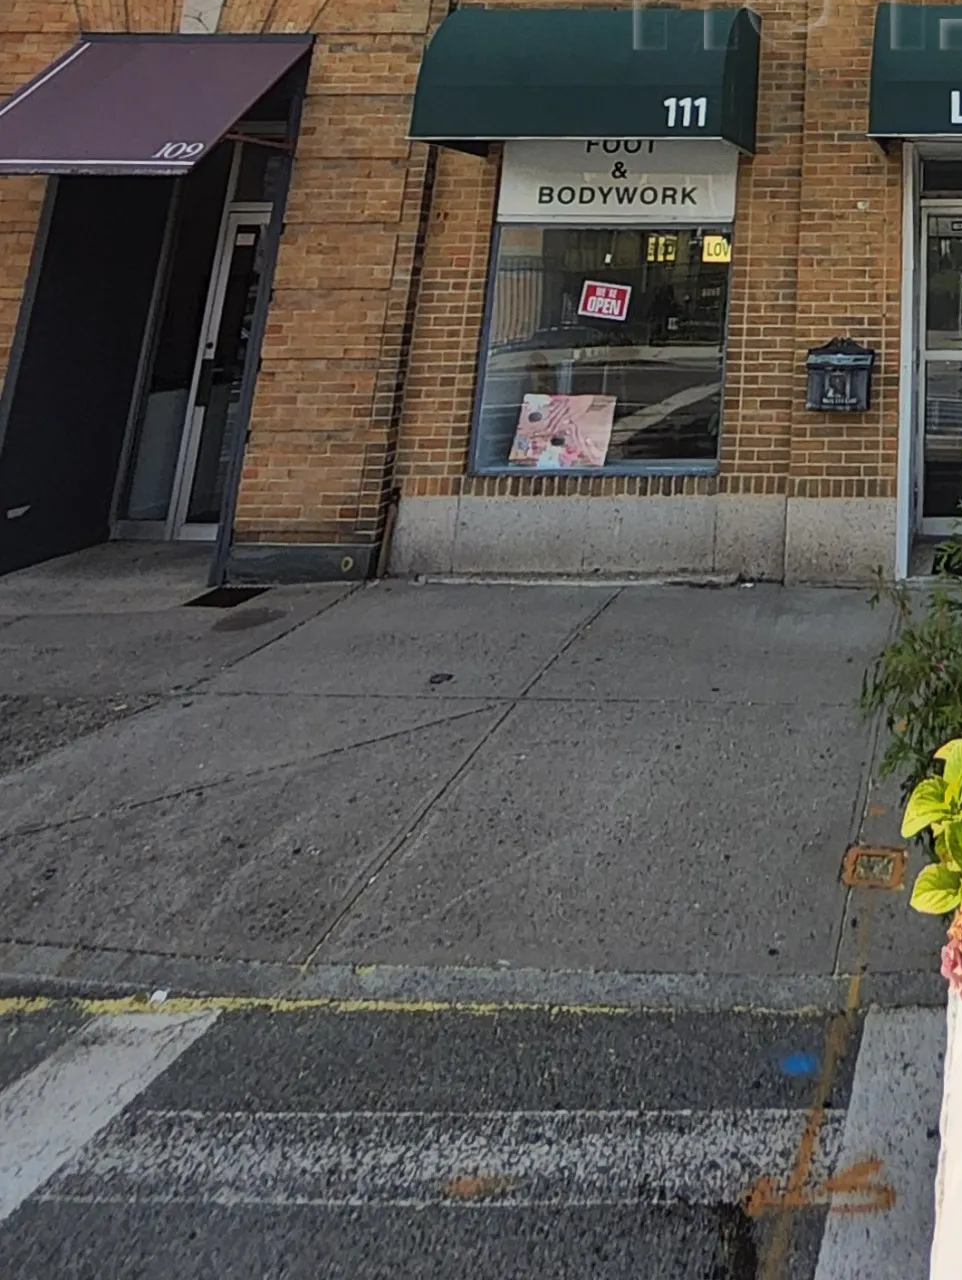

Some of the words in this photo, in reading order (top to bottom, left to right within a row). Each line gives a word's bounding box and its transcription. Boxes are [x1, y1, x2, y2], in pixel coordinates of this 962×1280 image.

[664, 97, 707, 127] 111
[152, 142, 204, 159] 109
[612, 161, 627, 179] &
[538, 186, 698, 205] BODYWORK
[587, 296, 622, 316] OPEN
